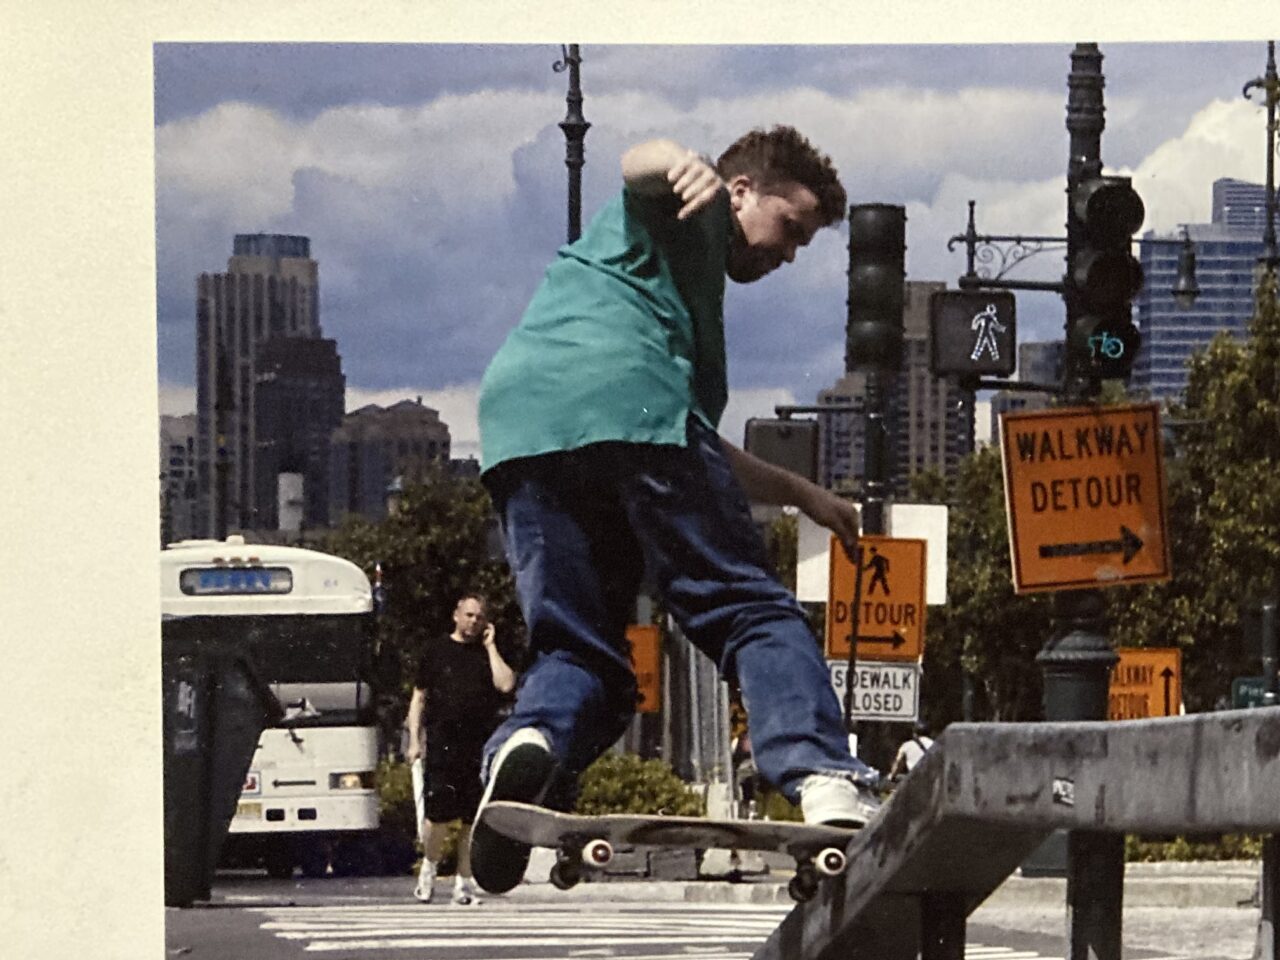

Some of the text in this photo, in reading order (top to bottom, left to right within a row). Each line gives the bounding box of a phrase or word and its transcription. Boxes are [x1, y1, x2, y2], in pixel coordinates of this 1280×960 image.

[1015, 422, 1150, 465] WALKWAY
[1031, 473, 1143, 513] DETOUR
[834, 600, 916, 626] DTOUR
[834, 669, 912, 691] SDEWALK
[1112, 664, 1155, 687] ALKWAY
[851, 692, 904, 712] LOSED
